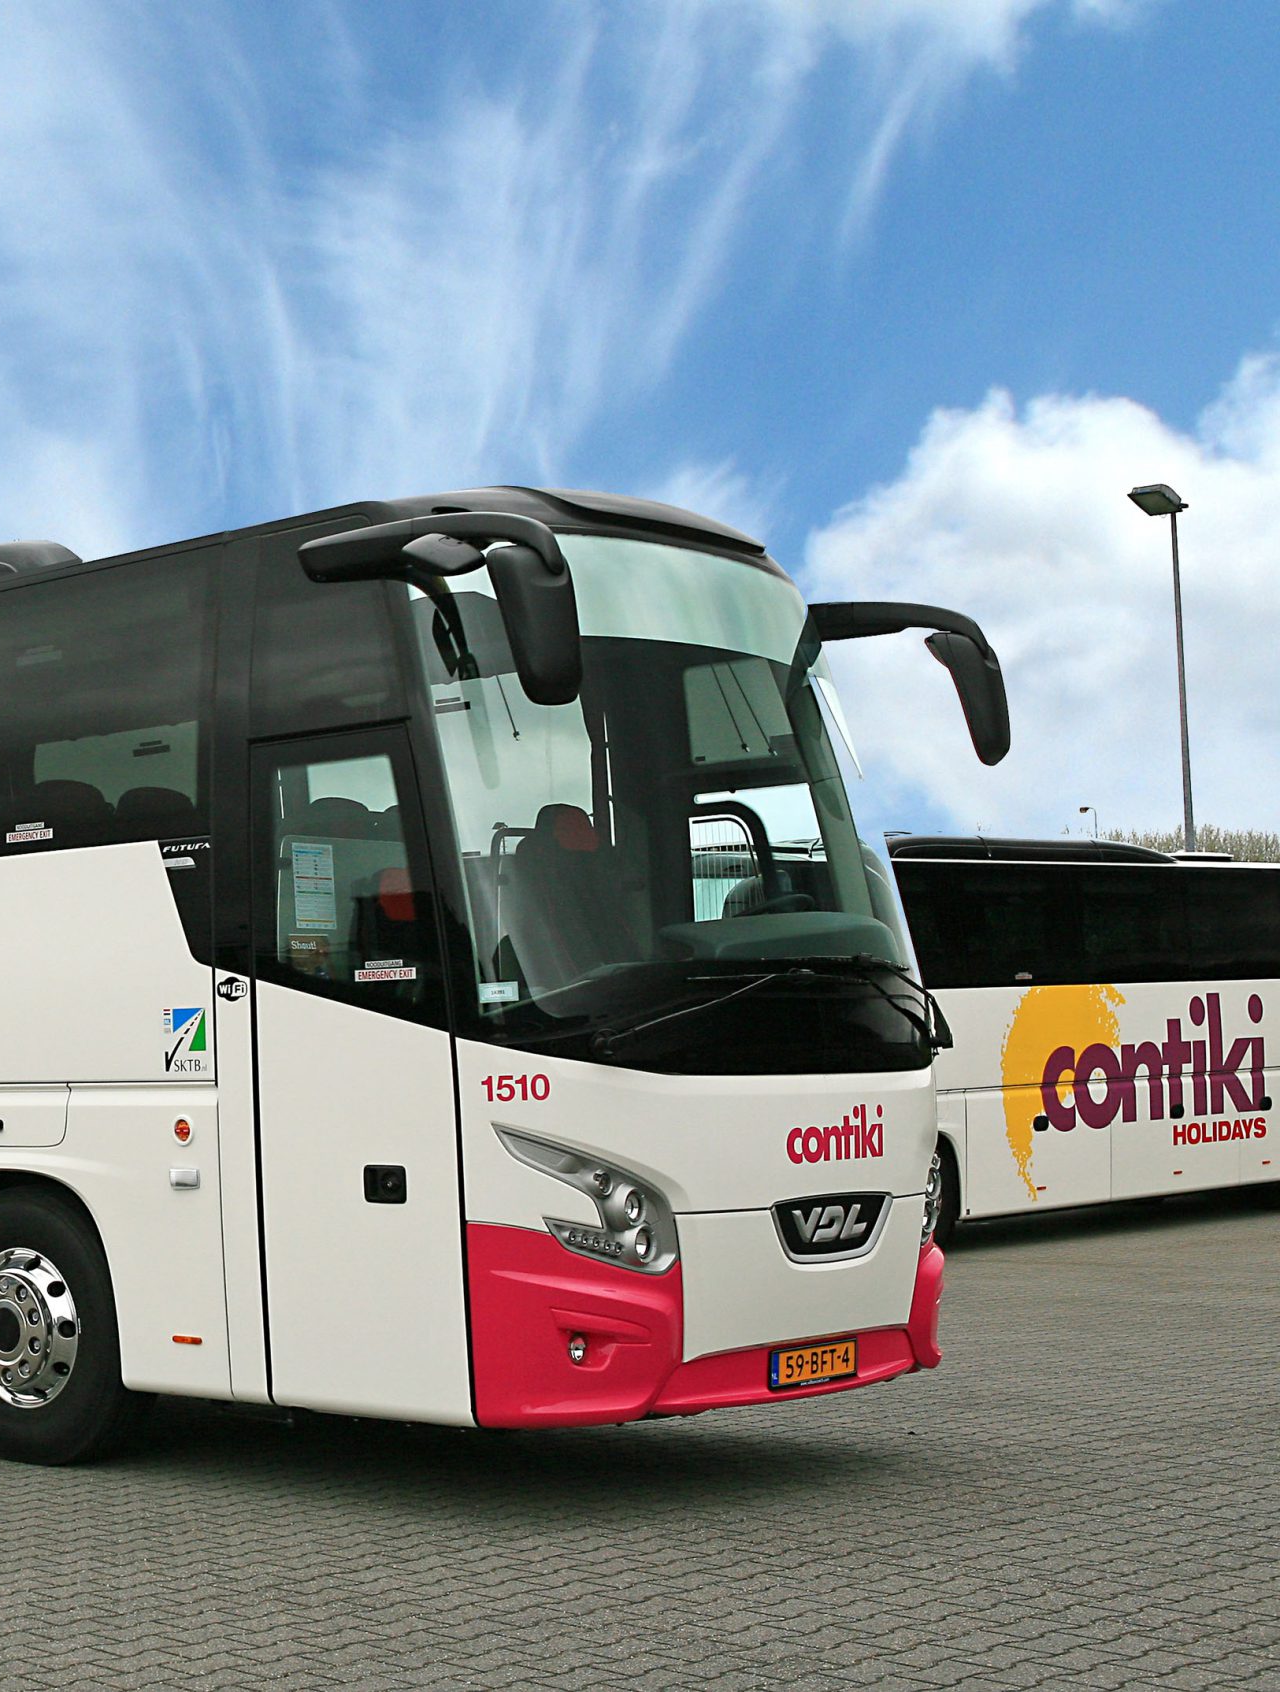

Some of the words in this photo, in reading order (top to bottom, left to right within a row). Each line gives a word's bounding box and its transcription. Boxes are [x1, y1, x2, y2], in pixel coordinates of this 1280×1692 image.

[8, 832, 39, 842] EMERGENCY
[40, 830, 51, 838] EXIT
[162, 842, 211, 853] FUTURA
[358, 970, 397, 981] EMERGENCY
[398, 969, 413, 979] EXIT
[1040, 993, 1265, 1132] contiki
[481, 1074, 551, 1102] 1510
[786, 1103, 884, 1165] contiki
[1173, 1117, 1268, 1146] HOLIDAYS
[792, 1204, 867, 1242] VDL
[785, 1346, 850, 1378] 59-BFT-4
